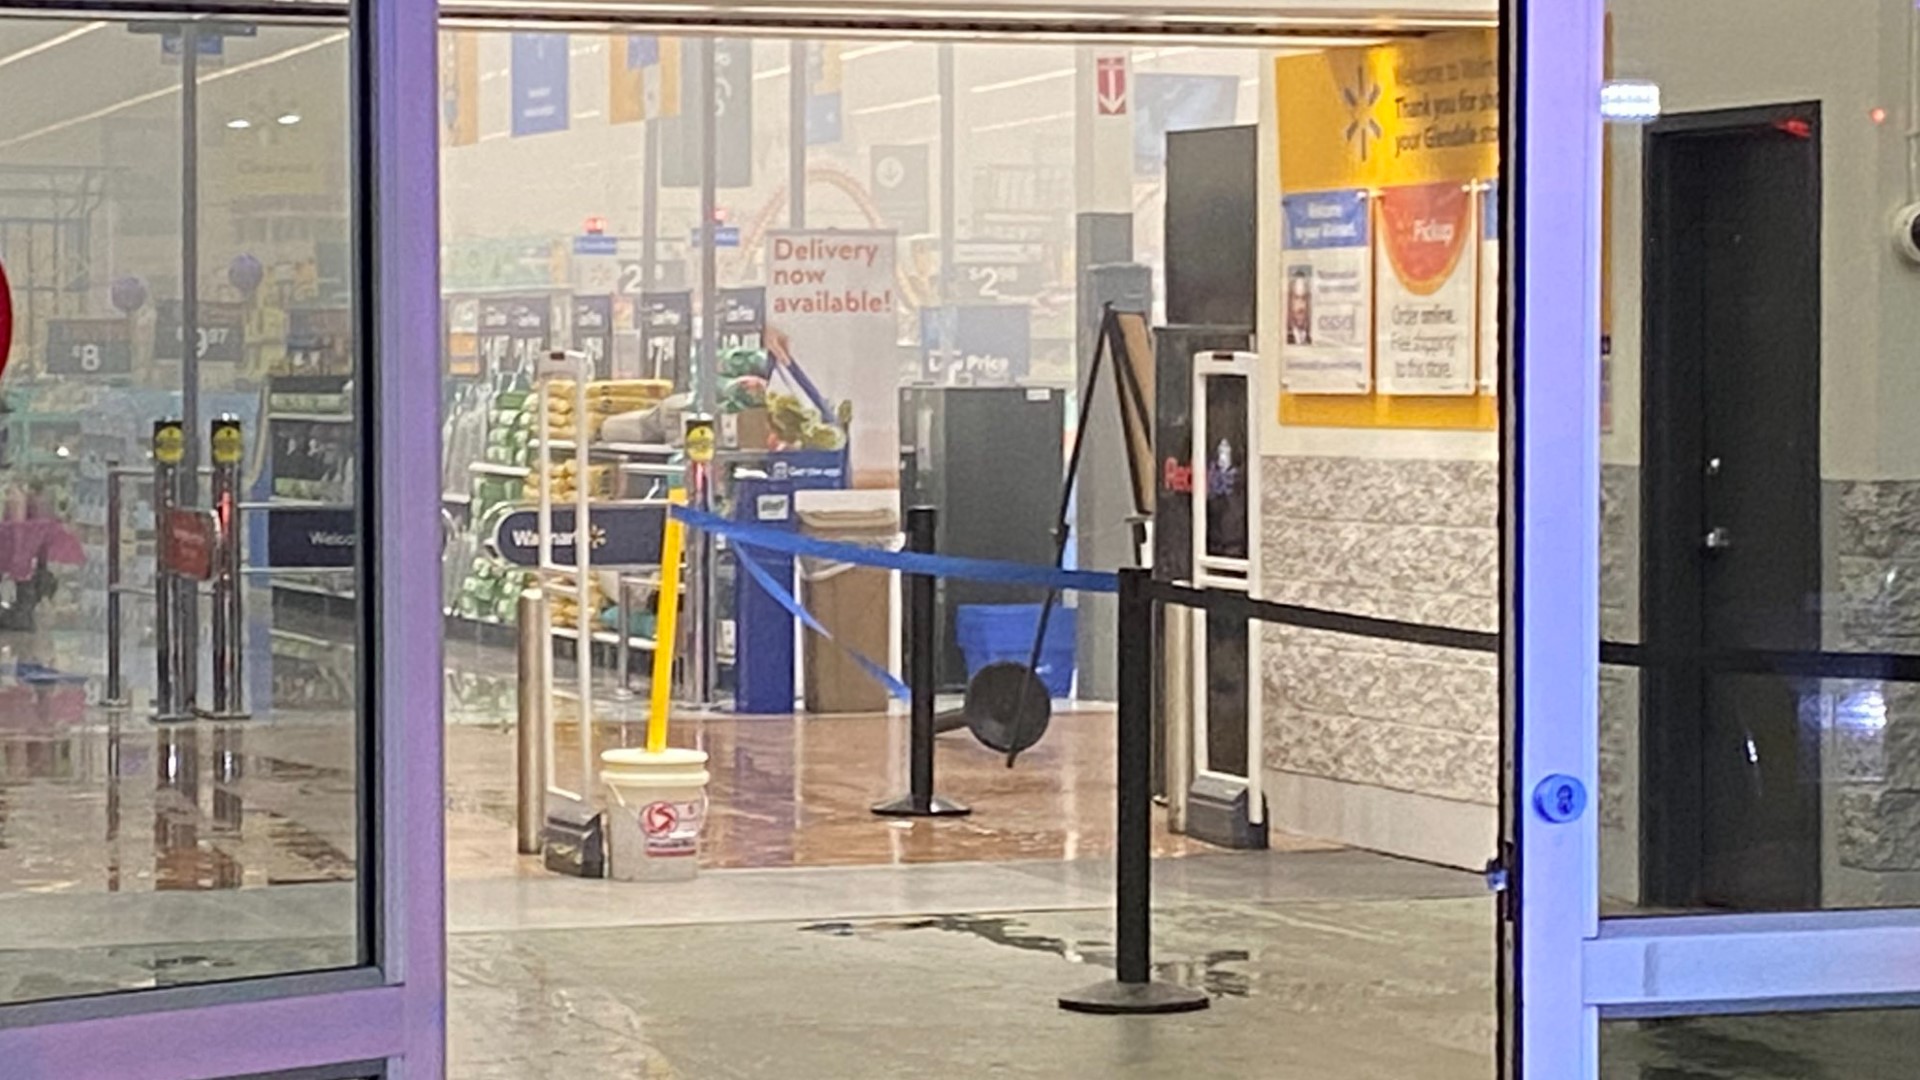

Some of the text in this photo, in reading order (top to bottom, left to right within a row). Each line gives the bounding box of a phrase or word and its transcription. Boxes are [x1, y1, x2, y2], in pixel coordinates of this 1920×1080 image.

[774, 237, 879, 267] Delivery
[774, 268, 827, 285] now
[774, 289, 892, 314] available!
